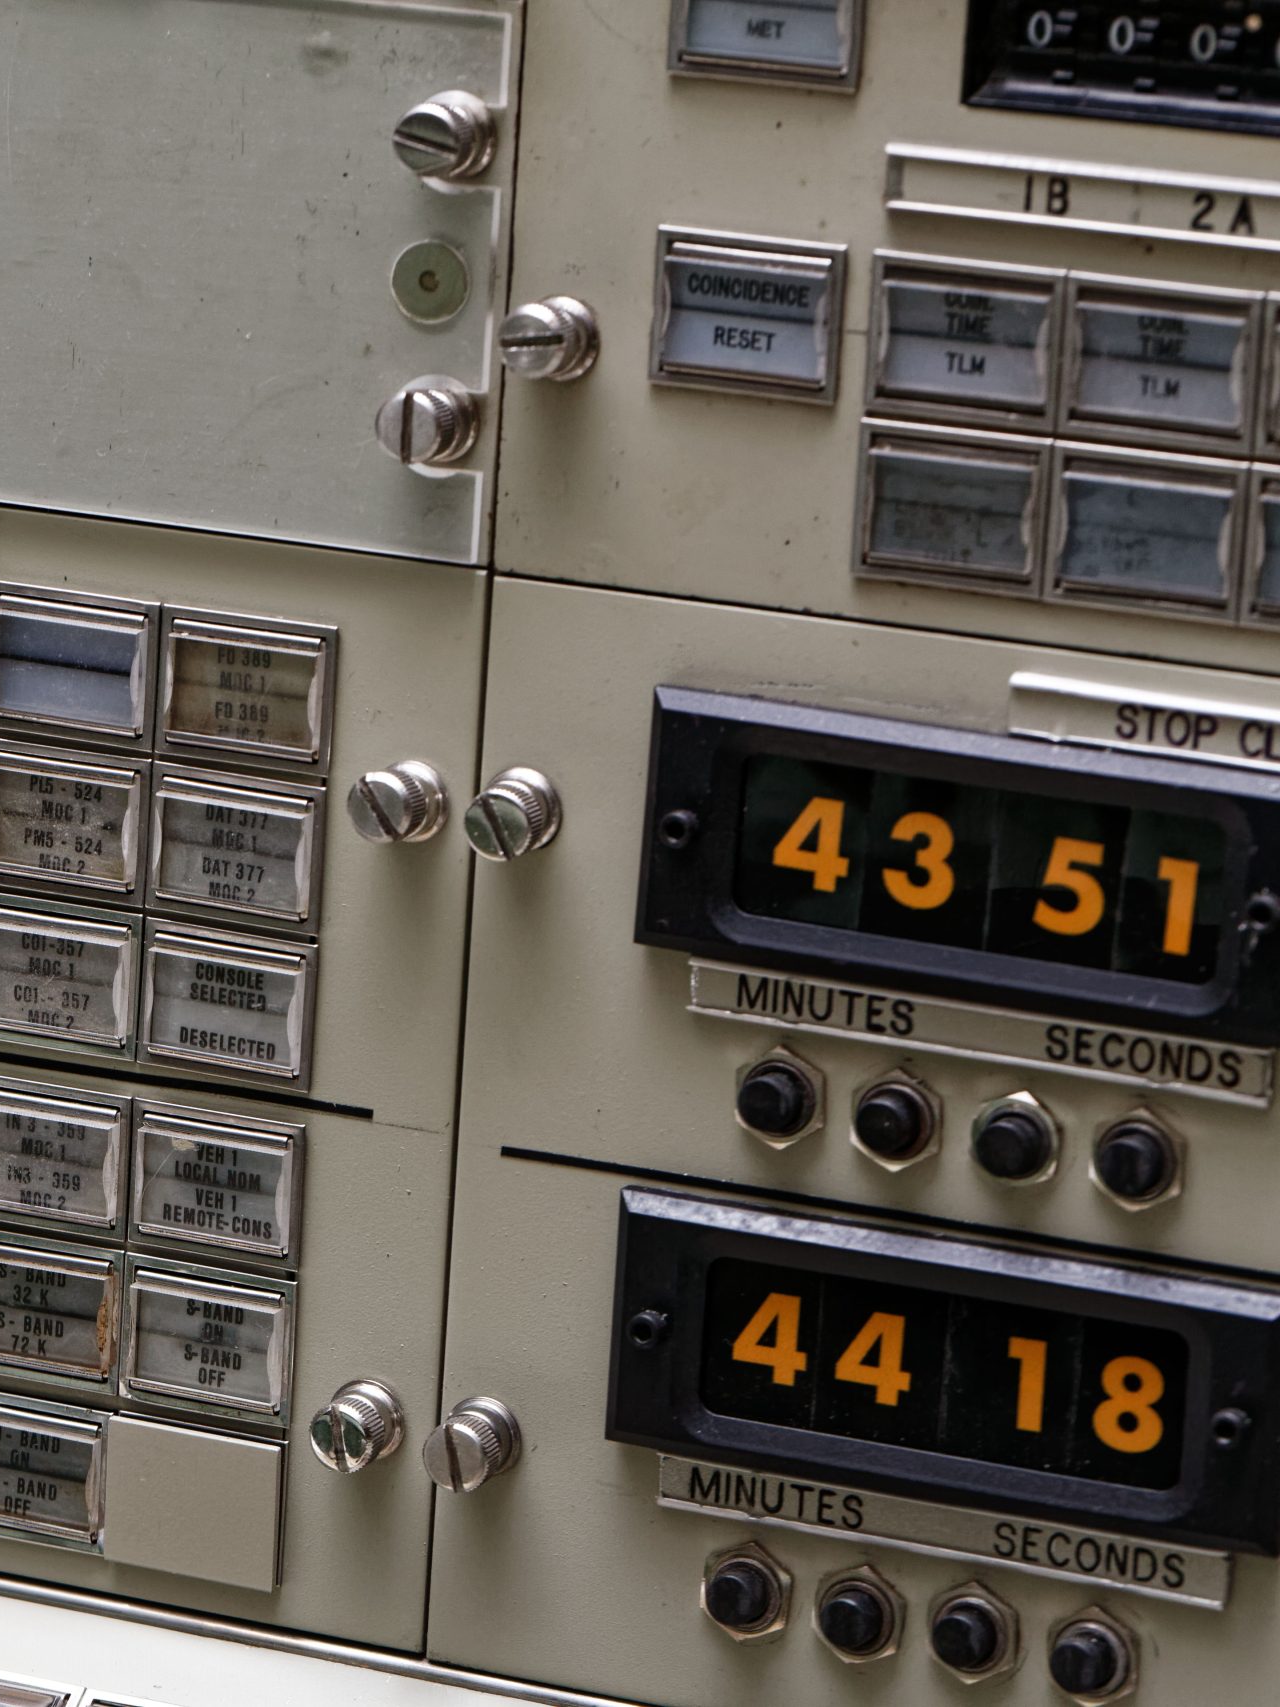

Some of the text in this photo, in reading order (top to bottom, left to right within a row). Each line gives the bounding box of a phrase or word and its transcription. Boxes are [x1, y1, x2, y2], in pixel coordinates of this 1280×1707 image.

[746, 19, 786, 40] MET
[687, 271, 811, 308] COINCIDENCE
[946, 312, 992, 334] TIME
[713, 325, 776, 353] RESET
[945, 352, 987, 376] TLM
[1139, 374, 1180, 398] TLM
[1115, 702, 1218, 750] STOP
[74, 783, 103, 803] 524
[75, 836, 103, 856] 524
[76, 860, 86, 874] 2
[235, 862, 265, 883] 377
[246, 888, 256, 902] 2
[195, 962, 265, 991] CONSOLE
[62, 991, 90, 1011] 357
[190, 982, 267, 1012] SELECTED
[736, 973, 1242, 1088] MINUTES SECONDS
[179, 1026, 276, 1061] DESELECTED
[196, 1143, 238, 1167] VEH 1
[52, 1172, 81, 1192] 359
[175, 1160, 261, 1191] LOCAL NOM
[57, 1195, 66, 1210] 2
[195, 1187, 237, 1212] VEH 1
[26, 1268, 66, 1287] BAND
[13, 1284, 49, 1306] 32 K
[23, 1315, 64, 1338] BAND
[203, 1323, 224, 1343] ON
[11, 1334, 47, 1356] 72 K
[184, 1343, 242, 1371] S-BAND
[198, 1367, 226, 1388] OFF
[20, 1430, 61, 1454] BAND
[10, 1449, 30, 1469] ON
[16, 1477, 57, 1501] BAND
[4, 1495, 32, 1516] OFF
[688, 1465, 1186, 1588] MINUTES SECONDS
